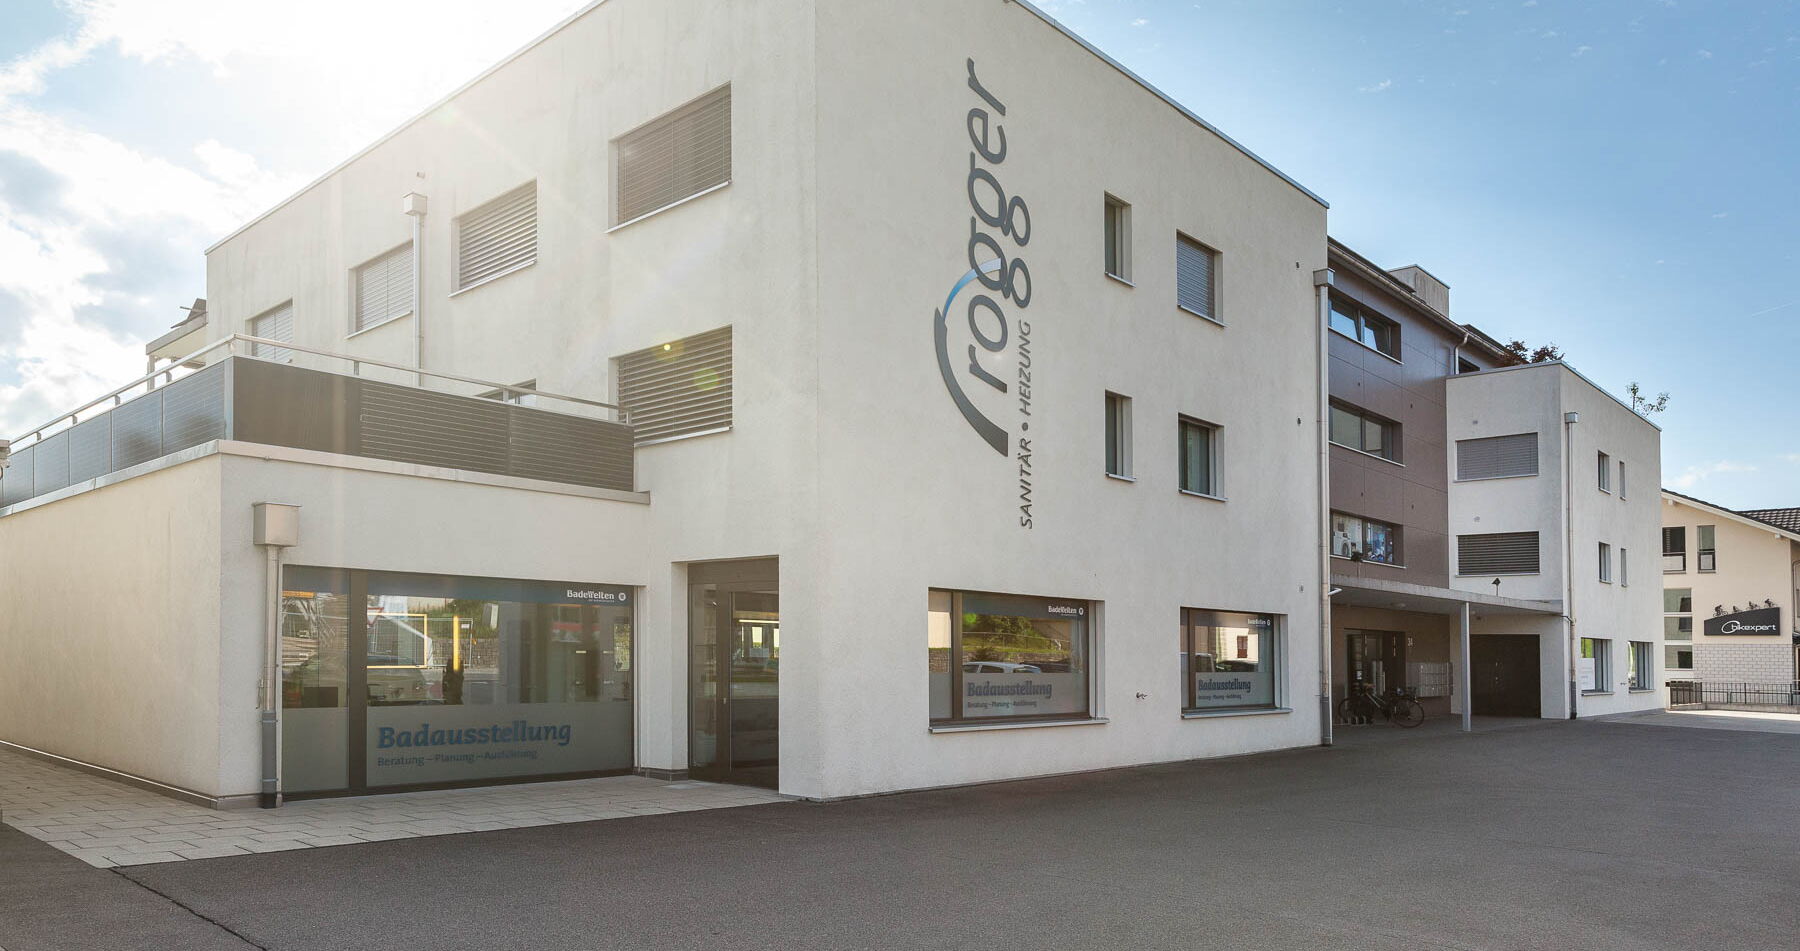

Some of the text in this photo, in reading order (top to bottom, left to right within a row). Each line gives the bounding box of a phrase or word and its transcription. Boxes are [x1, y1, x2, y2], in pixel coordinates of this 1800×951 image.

[966, 57, 1032, 394] rogger
[1017, 320, 1033, 530] SANITÄR HEIZUNG
[967, 680, 1052, 699] Badausstellung
[1198, 678, 1251, 693] Badausstellung
[376, 720, 572, 748] Badausstellung
[377, 756, 425, 767] Beratung
[434, 752, 475, 764] Planung
